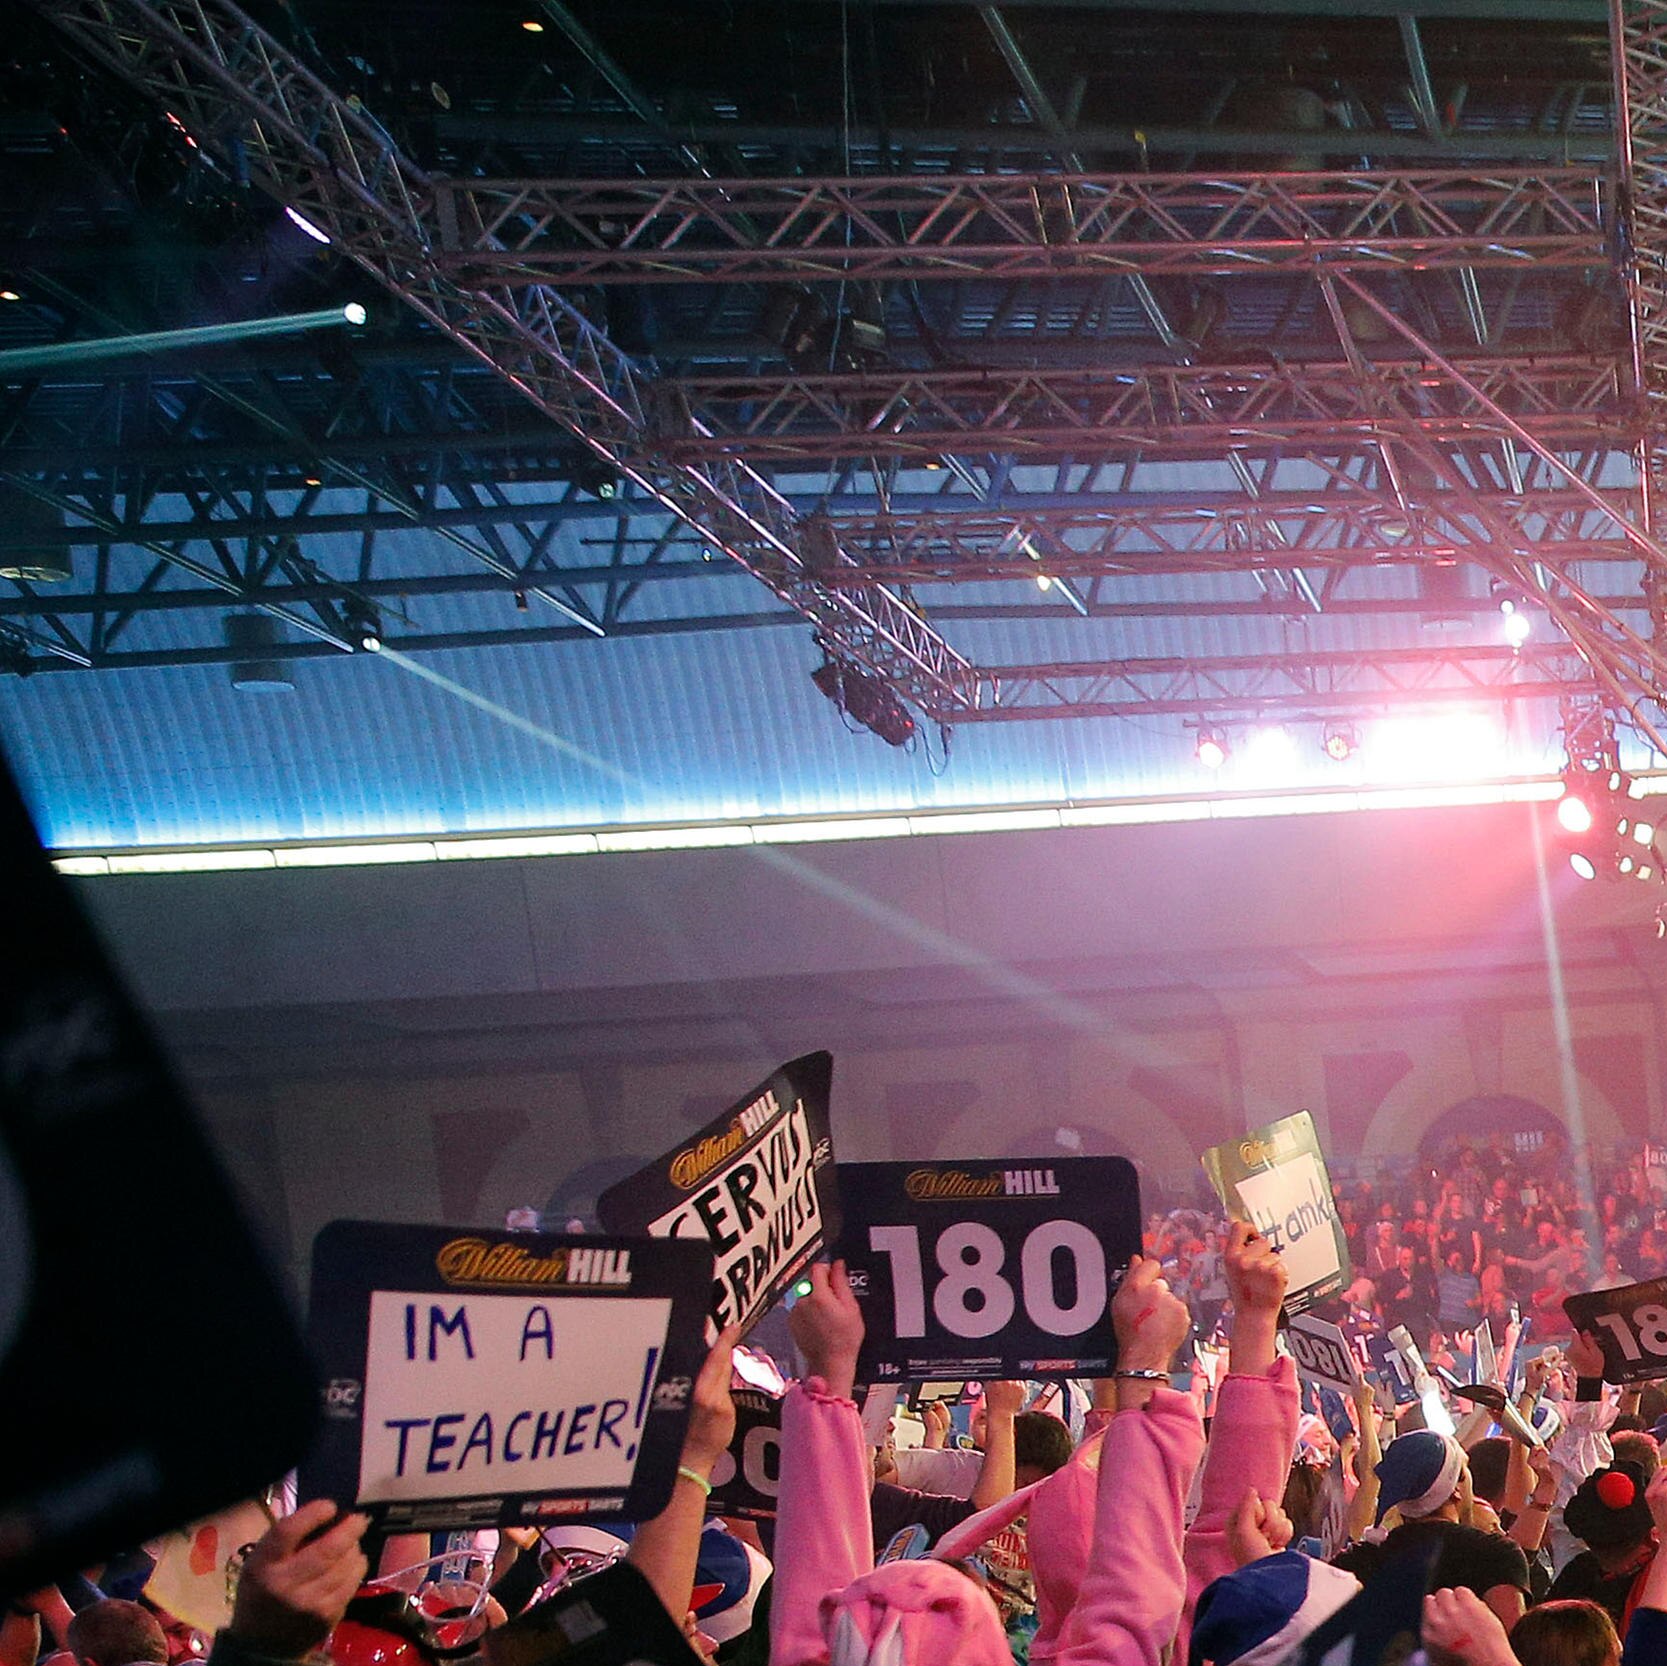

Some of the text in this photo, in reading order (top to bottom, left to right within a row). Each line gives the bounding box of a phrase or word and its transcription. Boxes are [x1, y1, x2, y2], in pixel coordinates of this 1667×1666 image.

[739, 1090, 780, 1138] HILL
[904, 1168, 1060, 1198] William HILL
[436, 1237, 633, 1284] William HILL
[869, 1219, 1108, 1339] 180
[405, 1303, 555, 1362] IM A
[384, 1347, 660, 1477] TEACHER!
